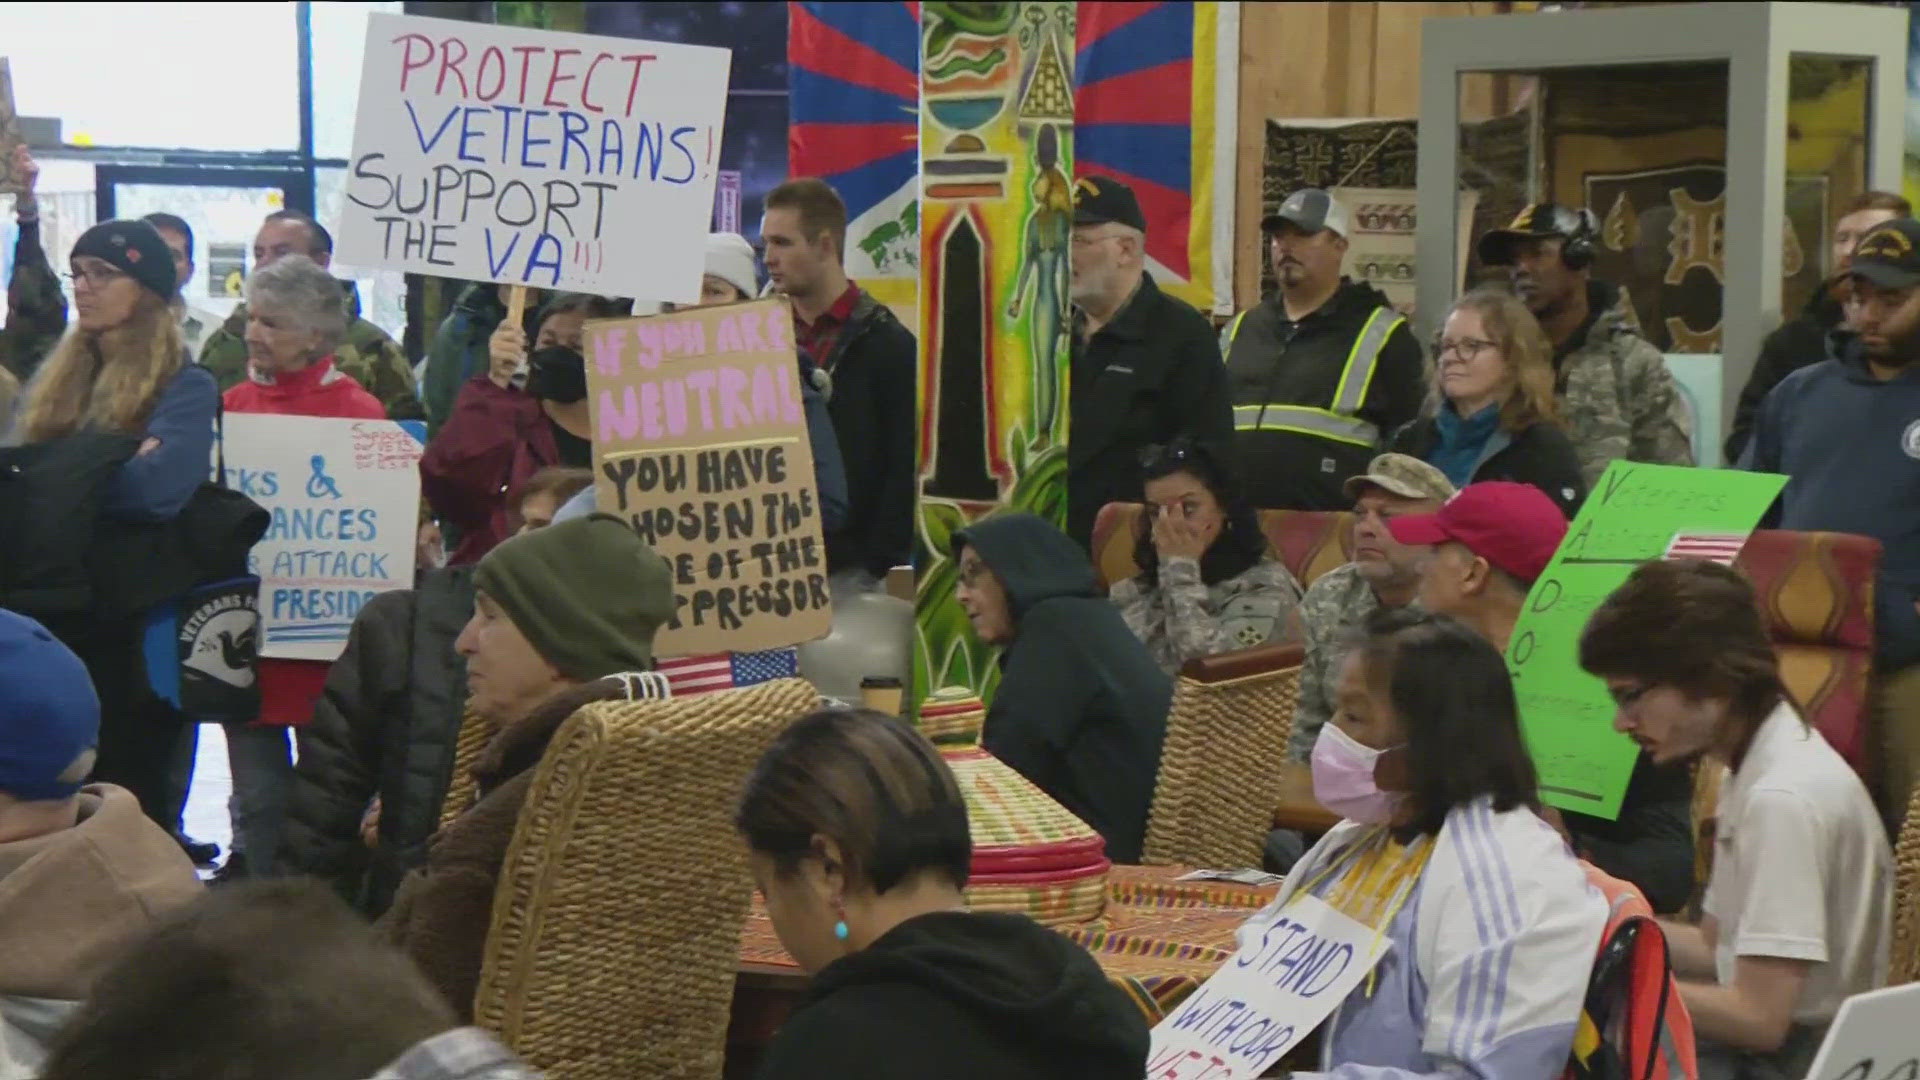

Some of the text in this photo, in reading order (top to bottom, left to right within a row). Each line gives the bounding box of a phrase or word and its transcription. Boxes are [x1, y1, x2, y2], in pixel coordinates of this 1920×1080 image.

[392, 33, 656, 117] PROTECT
[404, 100, 712, 184] VETERANS!
[347, 153, 618, 239] SUPPORT
[374, 216, 457, 266] THE
[593, 305, 787, 376] IF YOU ARE
[598, 363, 800, 443] NEUTRAL
[602, 446, 786, 511] YOU HAVE
[264, 506, 377, 542] ANCES
[632, 498, 753, 546] HOSEN
[273, 550, 389, 579] ATTACK
[707, 549, 743, 580] OF
[751, 536, 819, 577] THE
[180, 594, 241, 642] VETERANS
[668, 574, 829, 630] PPRESSOR
[1237, 918, 1354, 997] STAND
